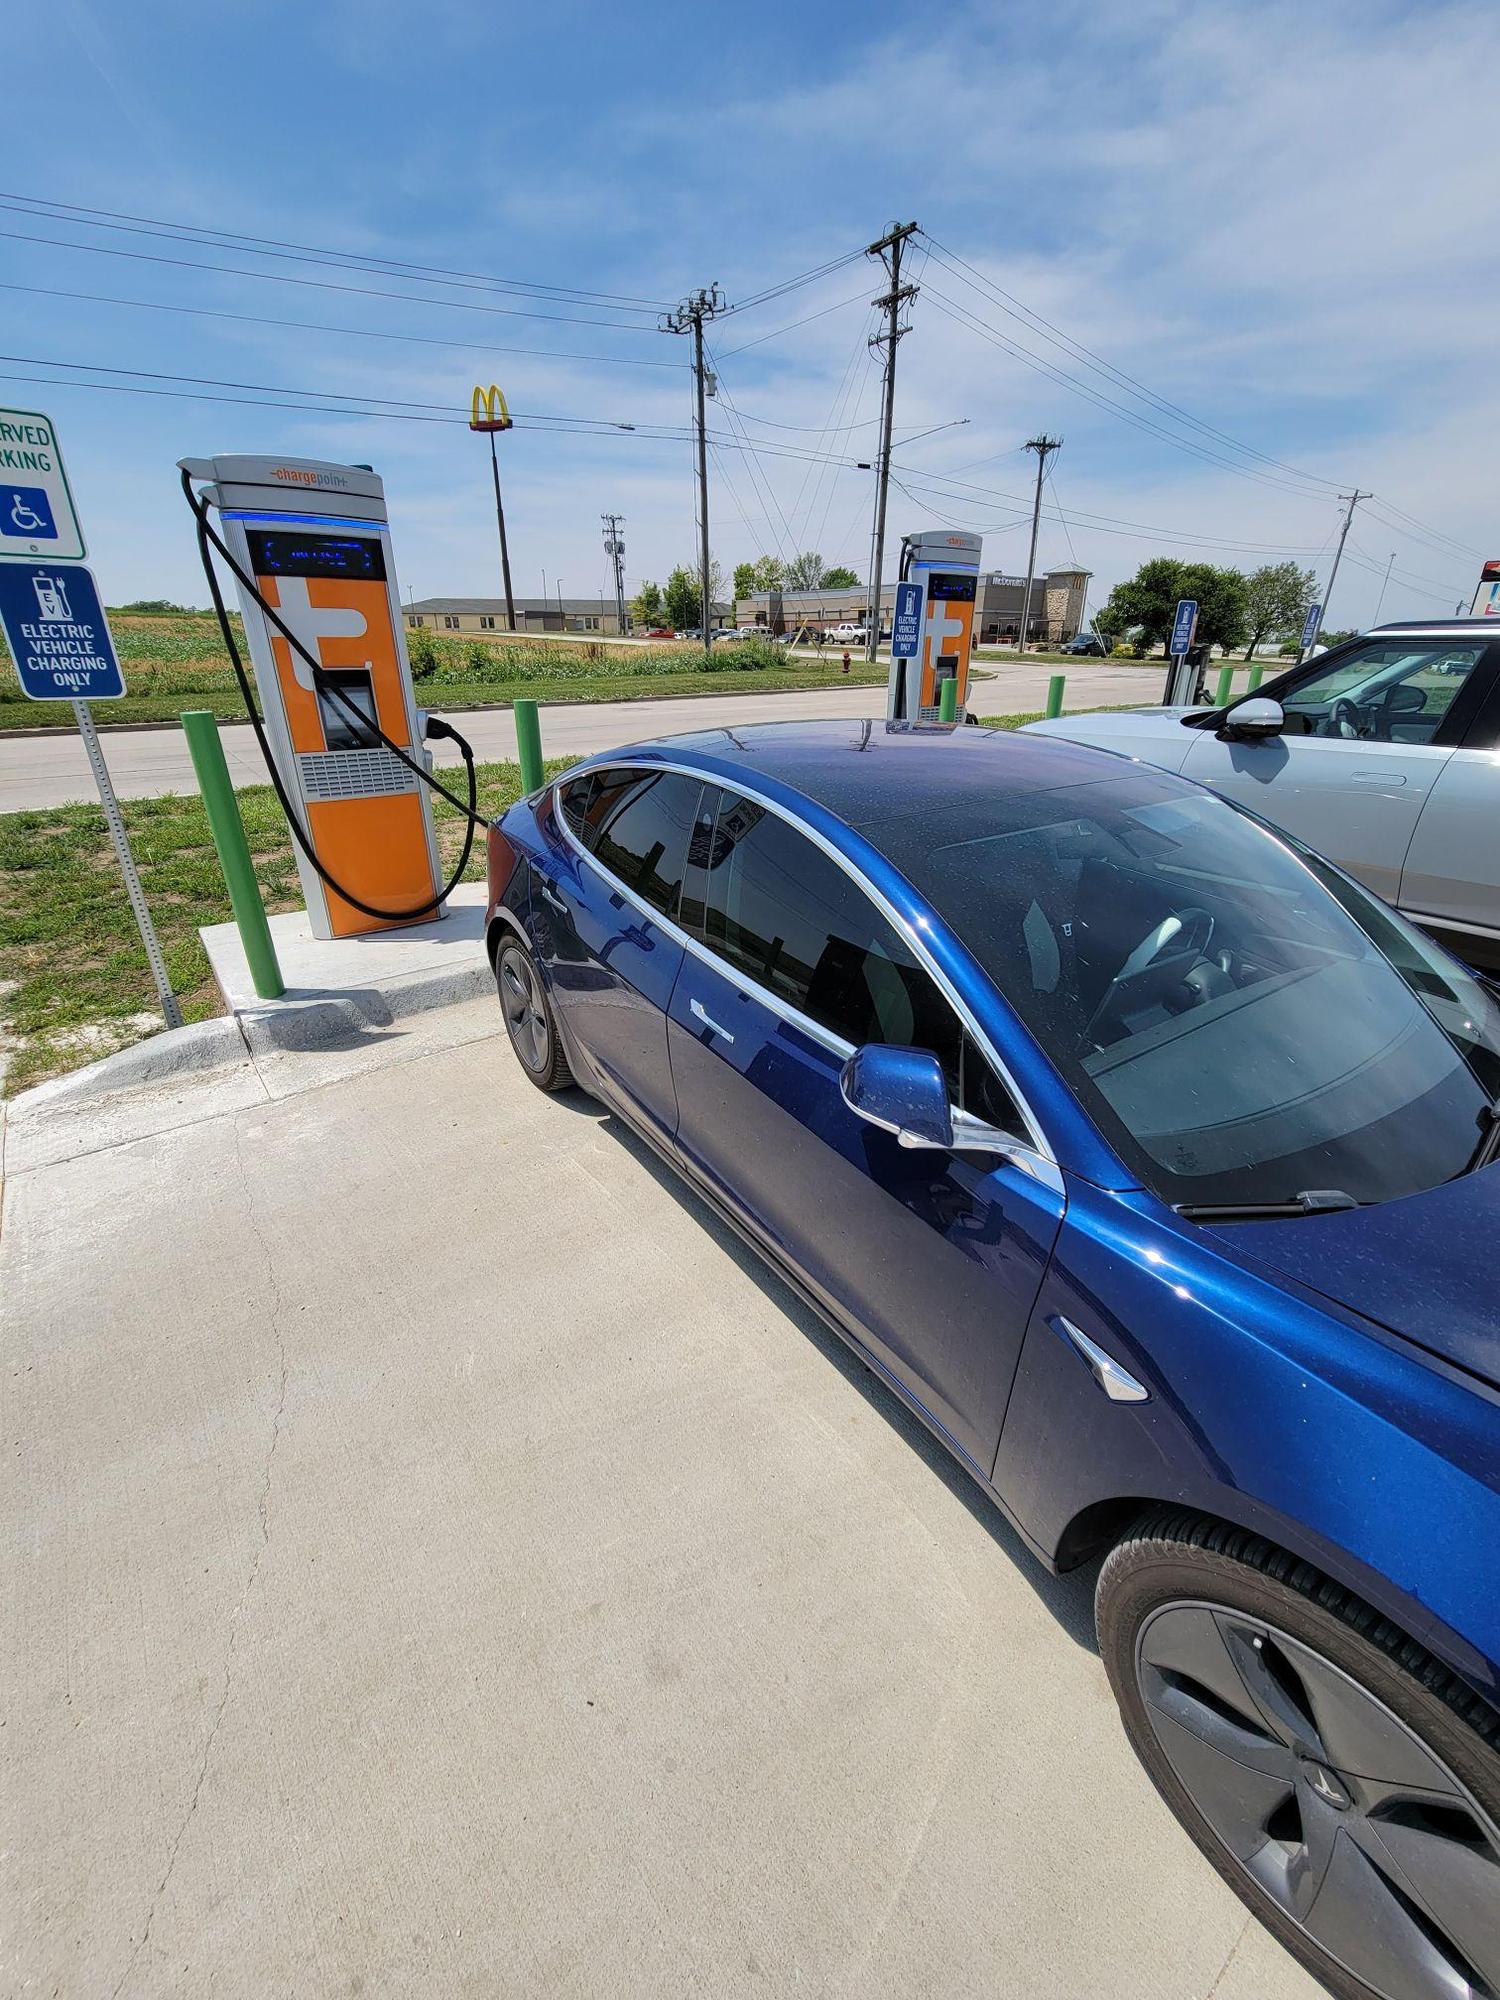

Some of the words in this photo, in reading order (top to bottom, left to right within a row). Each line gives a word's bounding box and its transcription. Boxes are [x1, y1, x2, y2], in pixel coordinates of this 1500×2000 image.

[0, 422, 50, 446] RVED
[20, 623, 95, 639] ELECTRIC
[29, 640, 96, 655] VEHICLE
[27, 656, 107, 671] CHARGING
[53, 672, 91, 686] ONLY
